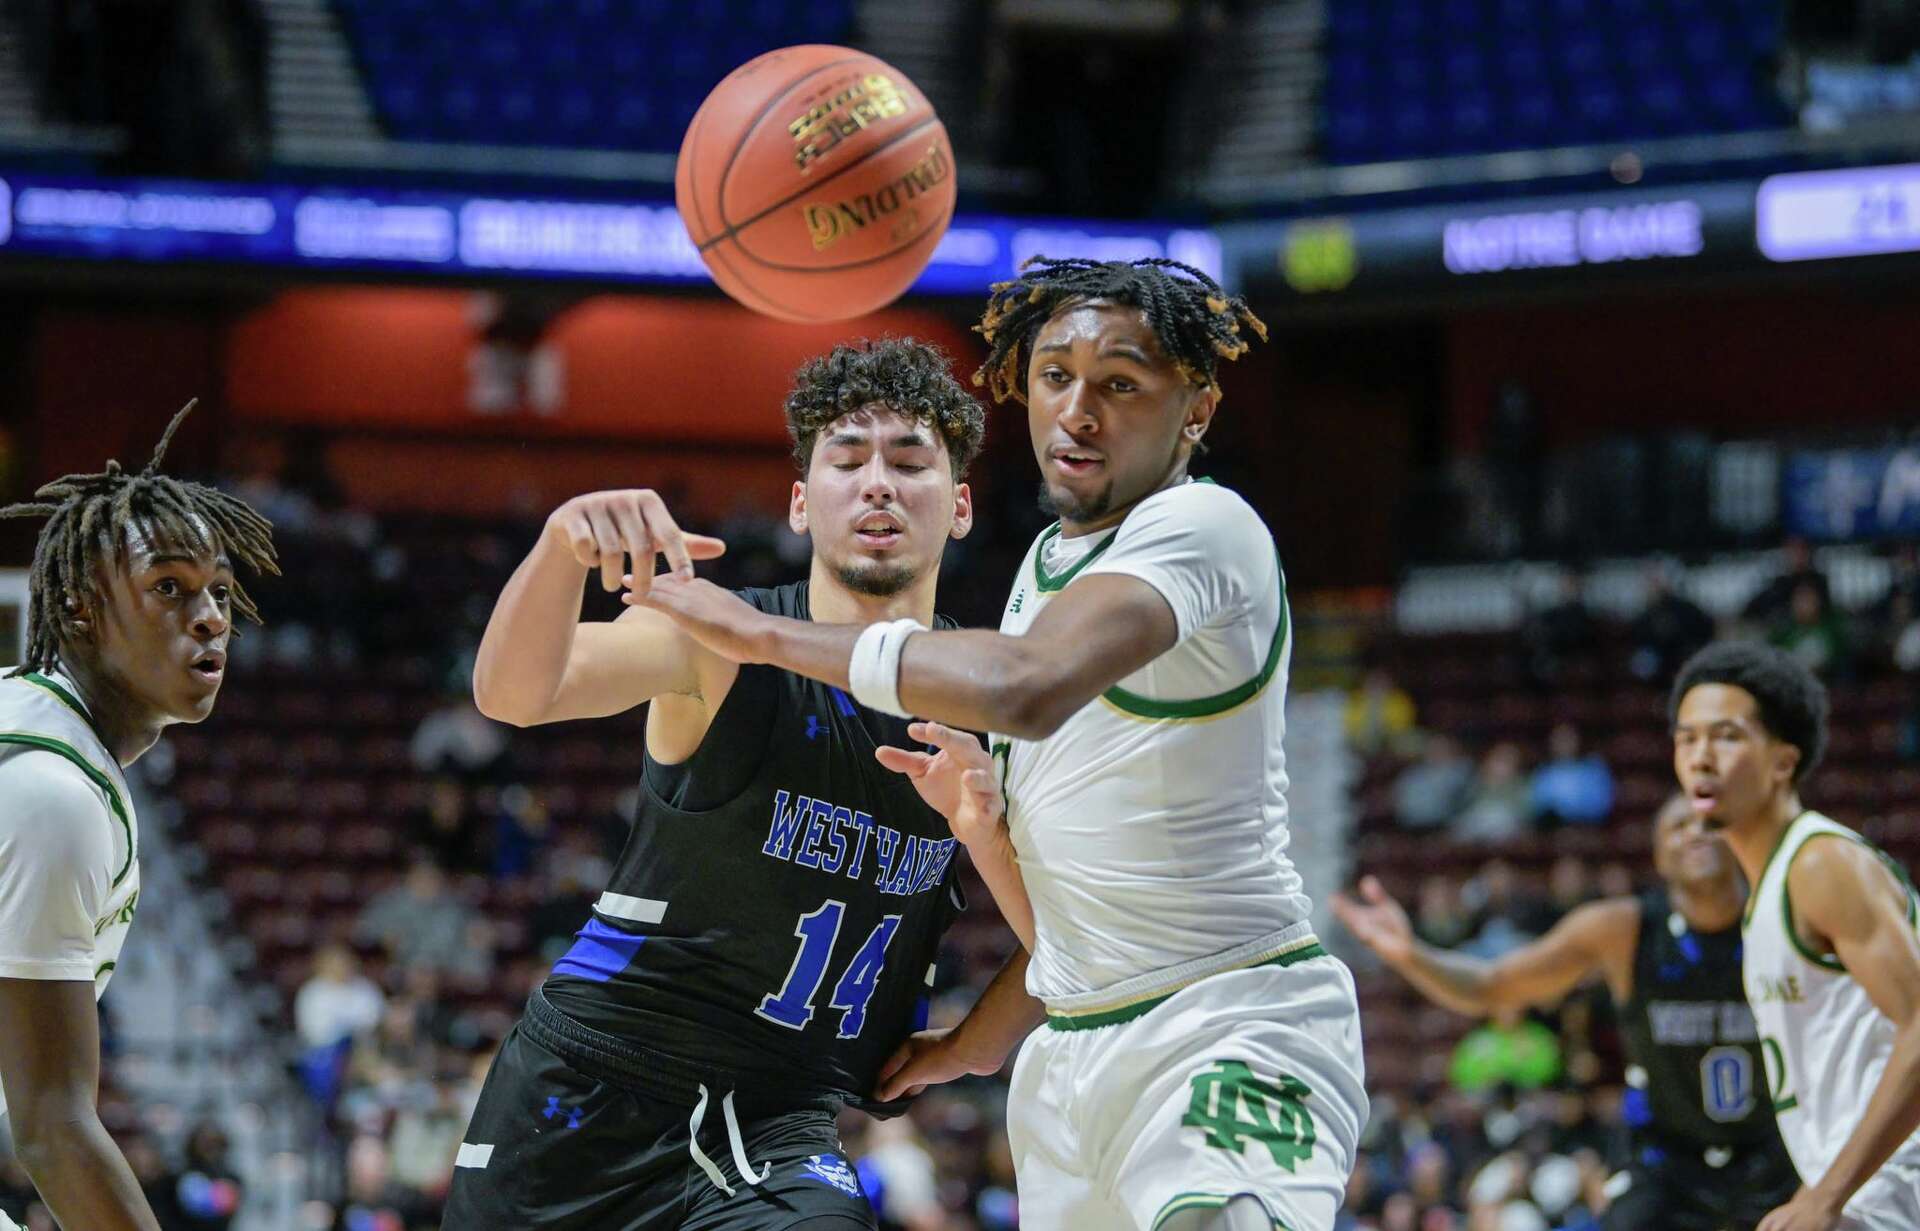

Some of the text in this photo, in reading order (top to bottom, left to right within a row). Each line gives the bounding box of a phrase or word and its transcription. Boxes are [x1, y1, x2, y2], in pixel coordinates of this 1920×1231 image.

[762, 789, 877, 880] WEST
[753, 898, 903, 1039] 14
[1701, 1046, 1755, 1123] 0
